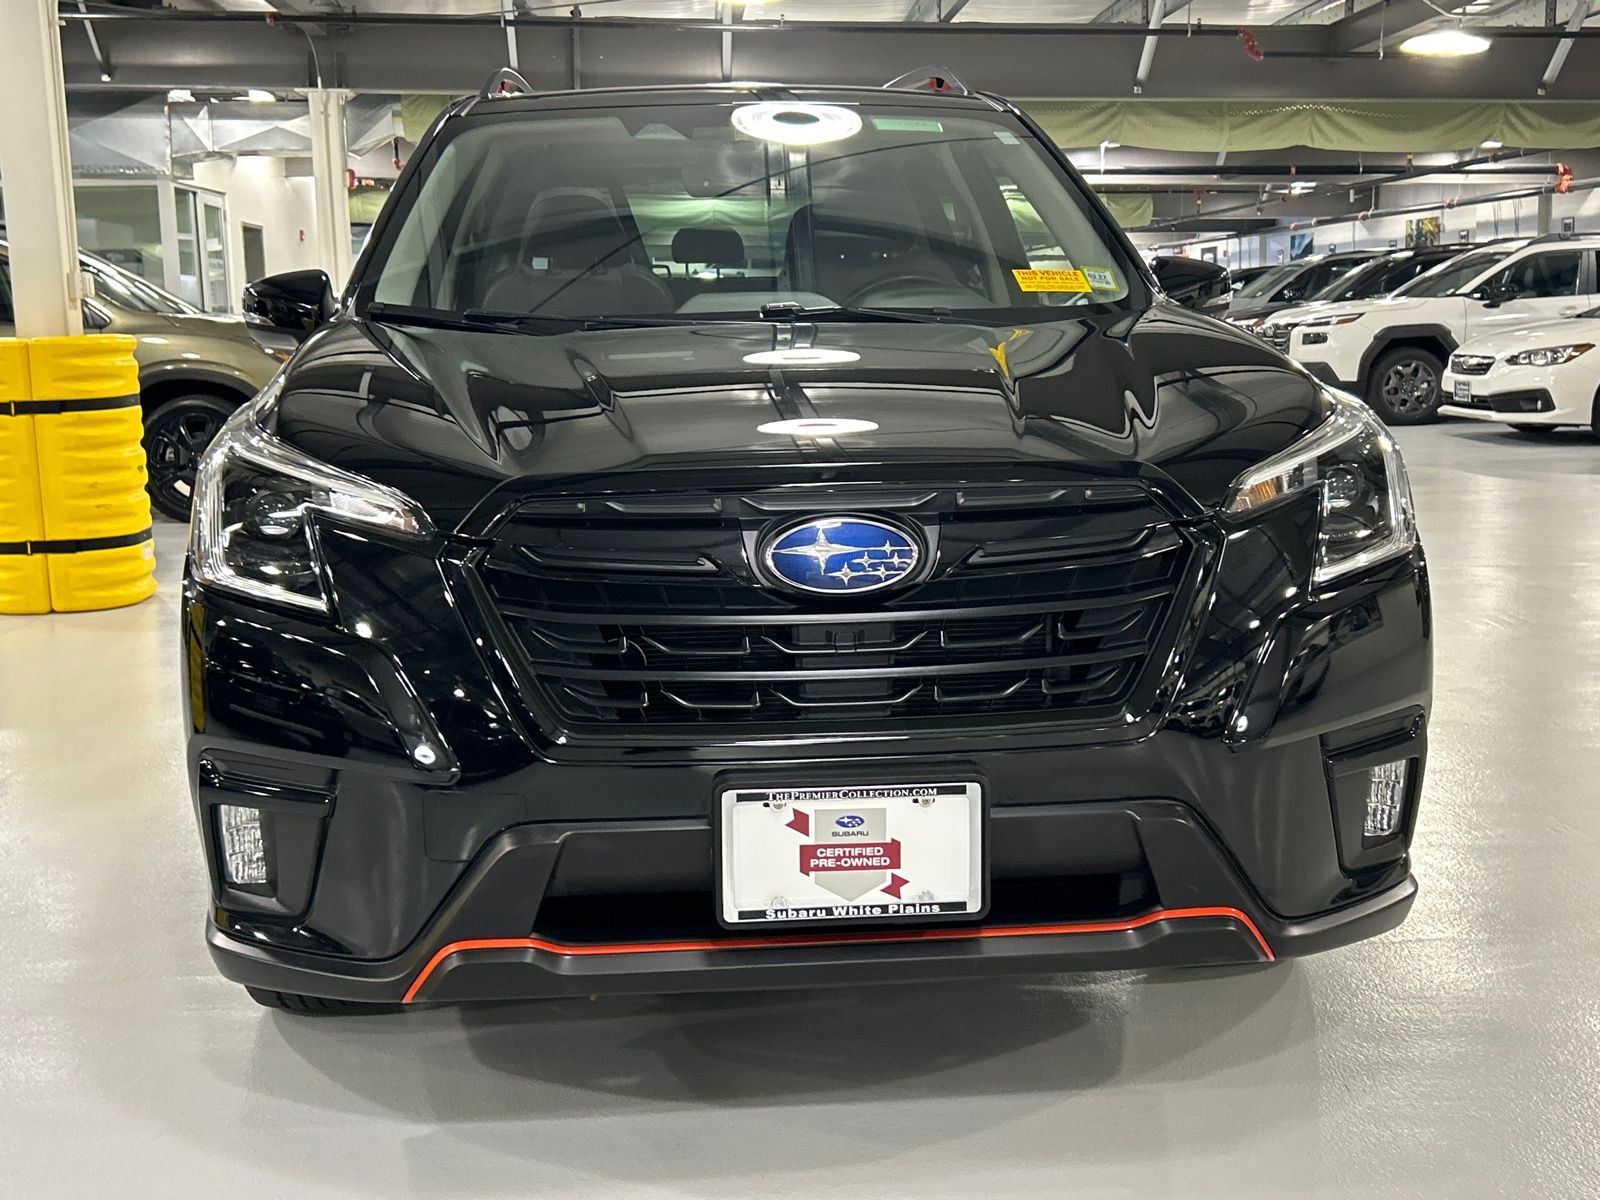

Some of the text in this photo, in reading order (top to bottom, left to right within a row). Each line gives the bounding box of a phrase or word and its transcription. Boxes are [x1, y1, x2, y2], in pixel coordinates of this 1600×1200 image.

[816, 847, 884, 857] CERTIFIED
[810, 856, 891, 868] PRE-OWNED
[765, 902, 941, 919] Subaru White Plains
